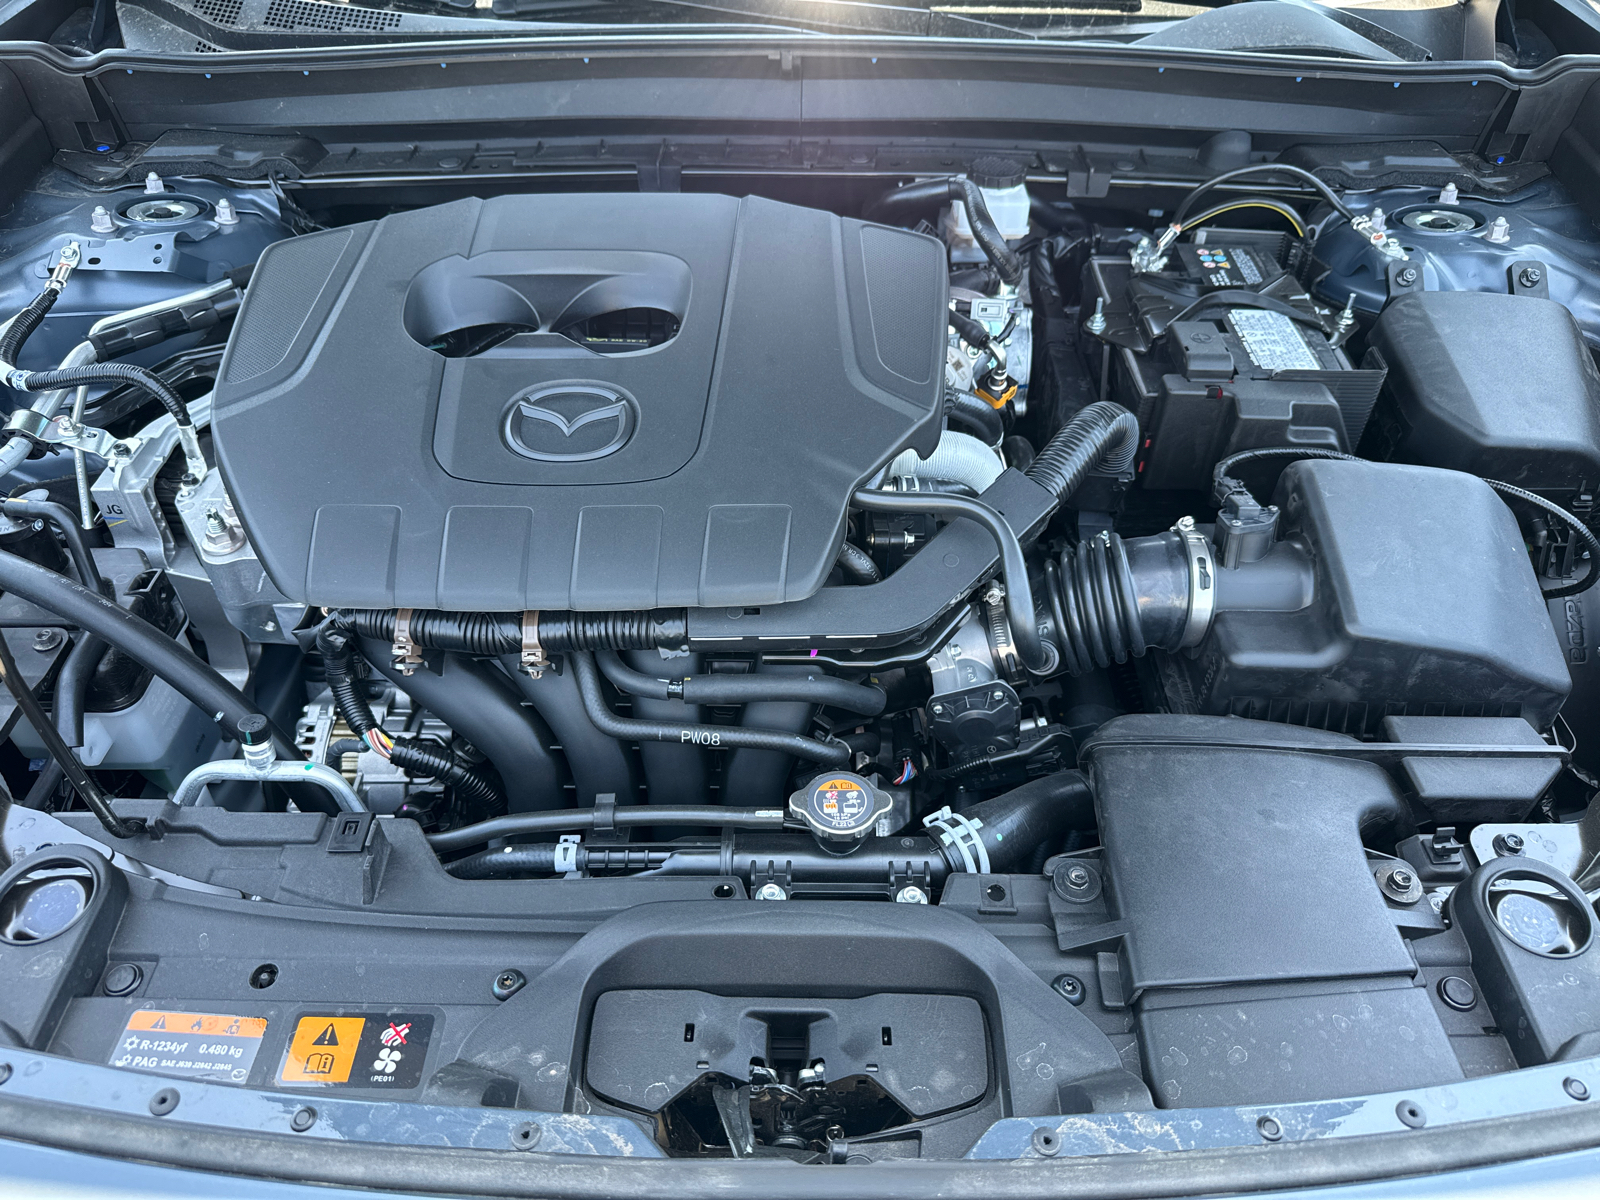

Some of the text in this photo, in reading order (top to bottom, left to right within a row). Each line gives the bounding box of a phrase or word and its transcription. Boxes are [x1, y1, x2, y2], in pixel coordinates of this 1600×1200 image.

[106, 504, 123, 515] JG
[681, 730, 720, 746] PW08
[140, 1040, 243, 1058] R-1234yf 0.480 kg
[132, 1056, 158, 1067] PAG
[161, 1059, 176, 1067] SAE
